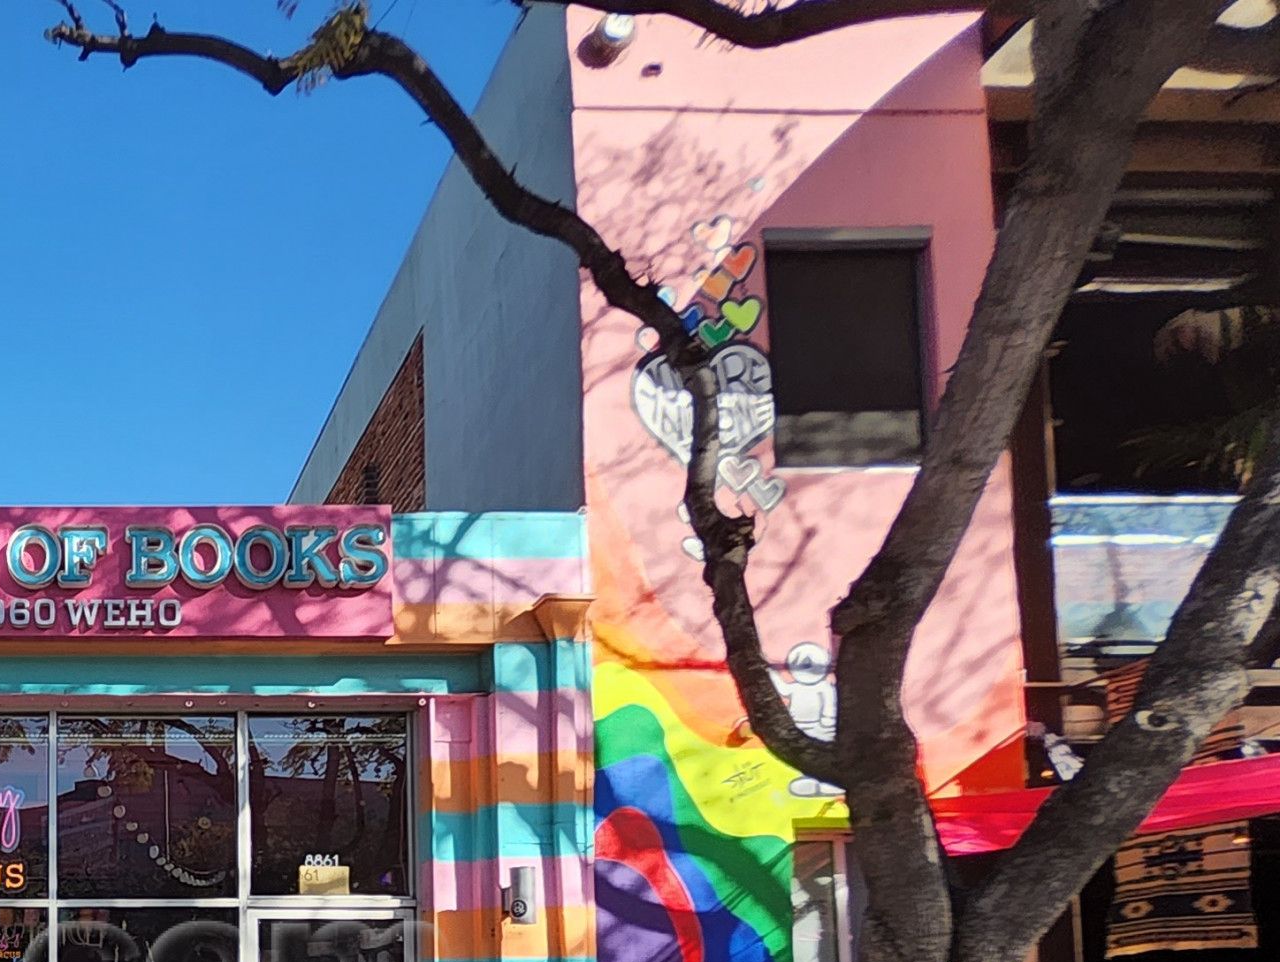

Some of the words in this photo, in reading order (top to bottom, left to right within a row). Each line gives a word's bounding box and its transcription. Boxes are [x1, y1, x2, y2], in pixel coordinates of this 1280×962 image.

[5, 524, 107, 589] OF
[127, 524, 387, 591] BOOKS
[66, 600, 182, 628] WEHO
[305, 854, 339, 866] 8861
